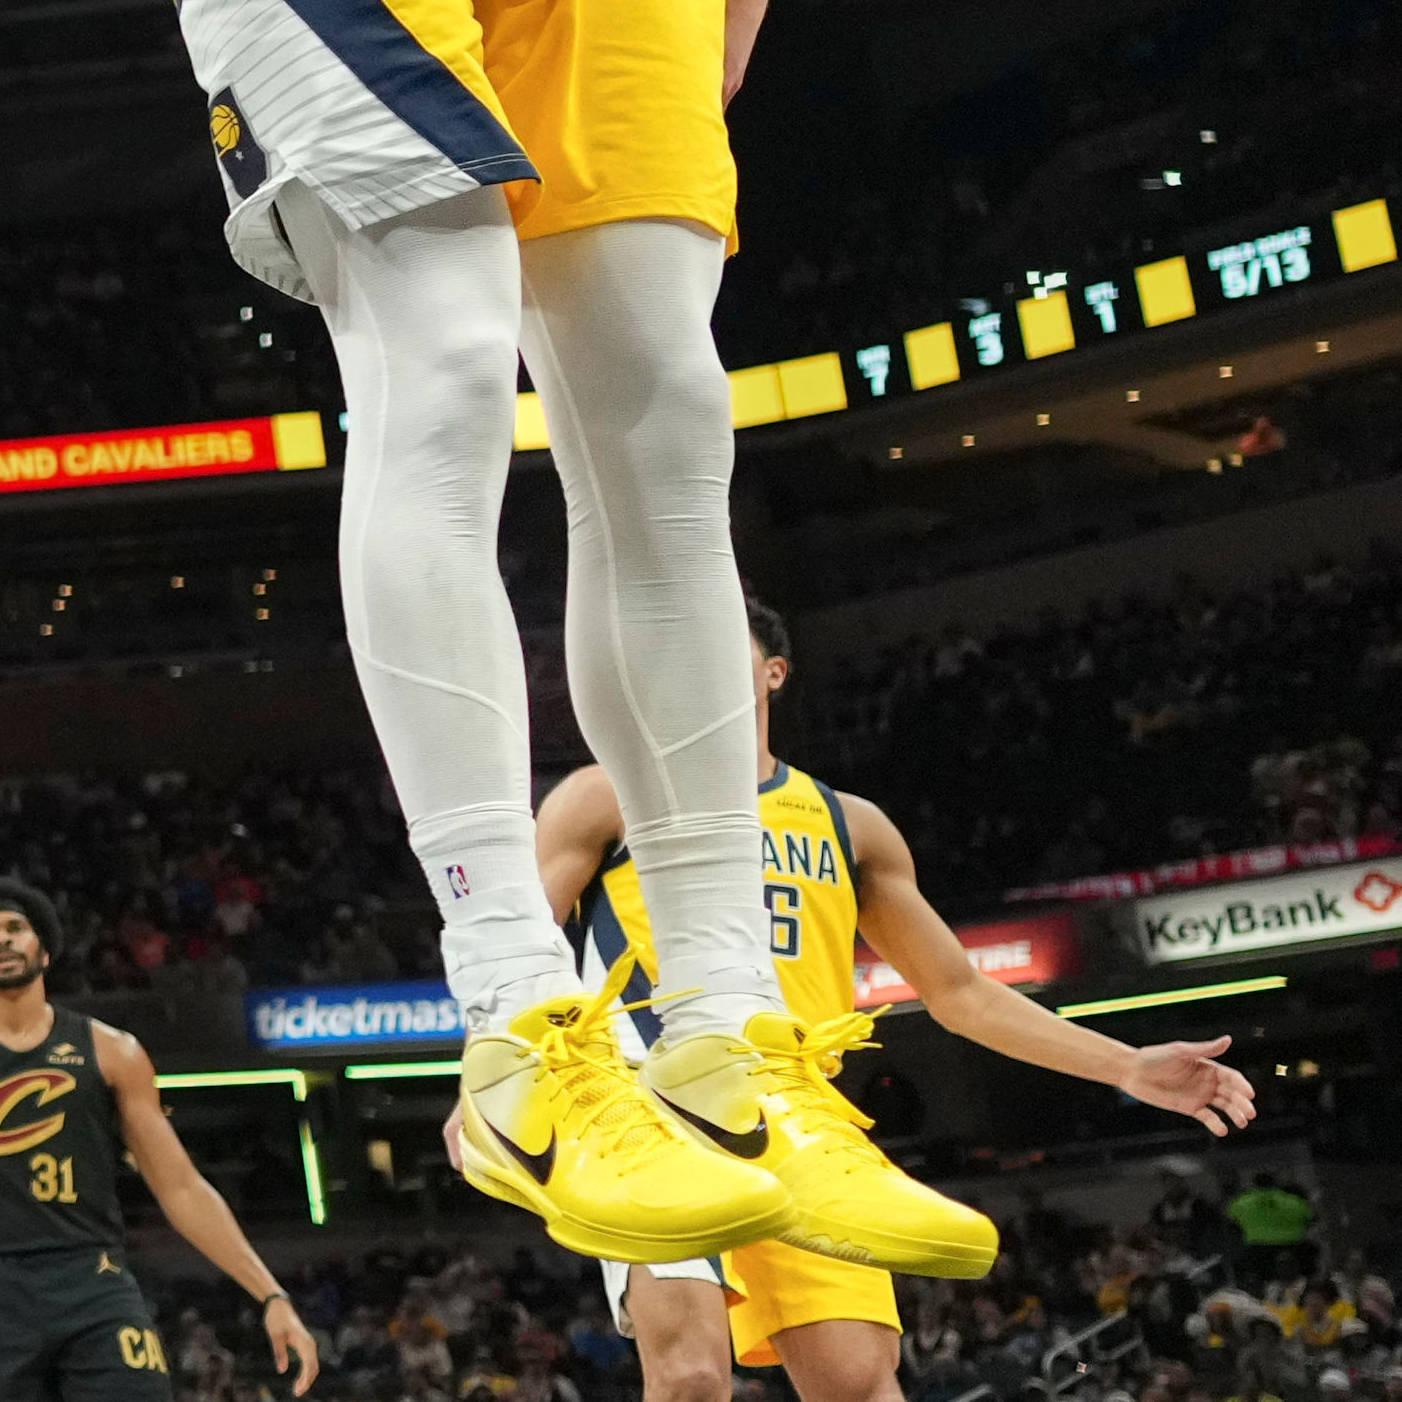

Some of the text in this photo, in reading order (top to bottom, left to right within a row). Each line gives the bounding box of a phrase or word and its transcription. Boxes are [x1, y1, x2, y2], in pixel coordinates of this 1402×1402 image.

[1220, 246, 1313, 300] 5/13
[1092, 299, 1118, 334] 1
[974, 332, 1004, 366] 3
[861, 363, 890, 397] 7
[61, 429, 254, 479] CAVALIERS
[1145, 889, 1345, 955] KeyBank
[253, 996, 464, 1045] ticketmas
[29, 1153, 79, 1205] 31
[117, 1325, 170, 1374] CA
